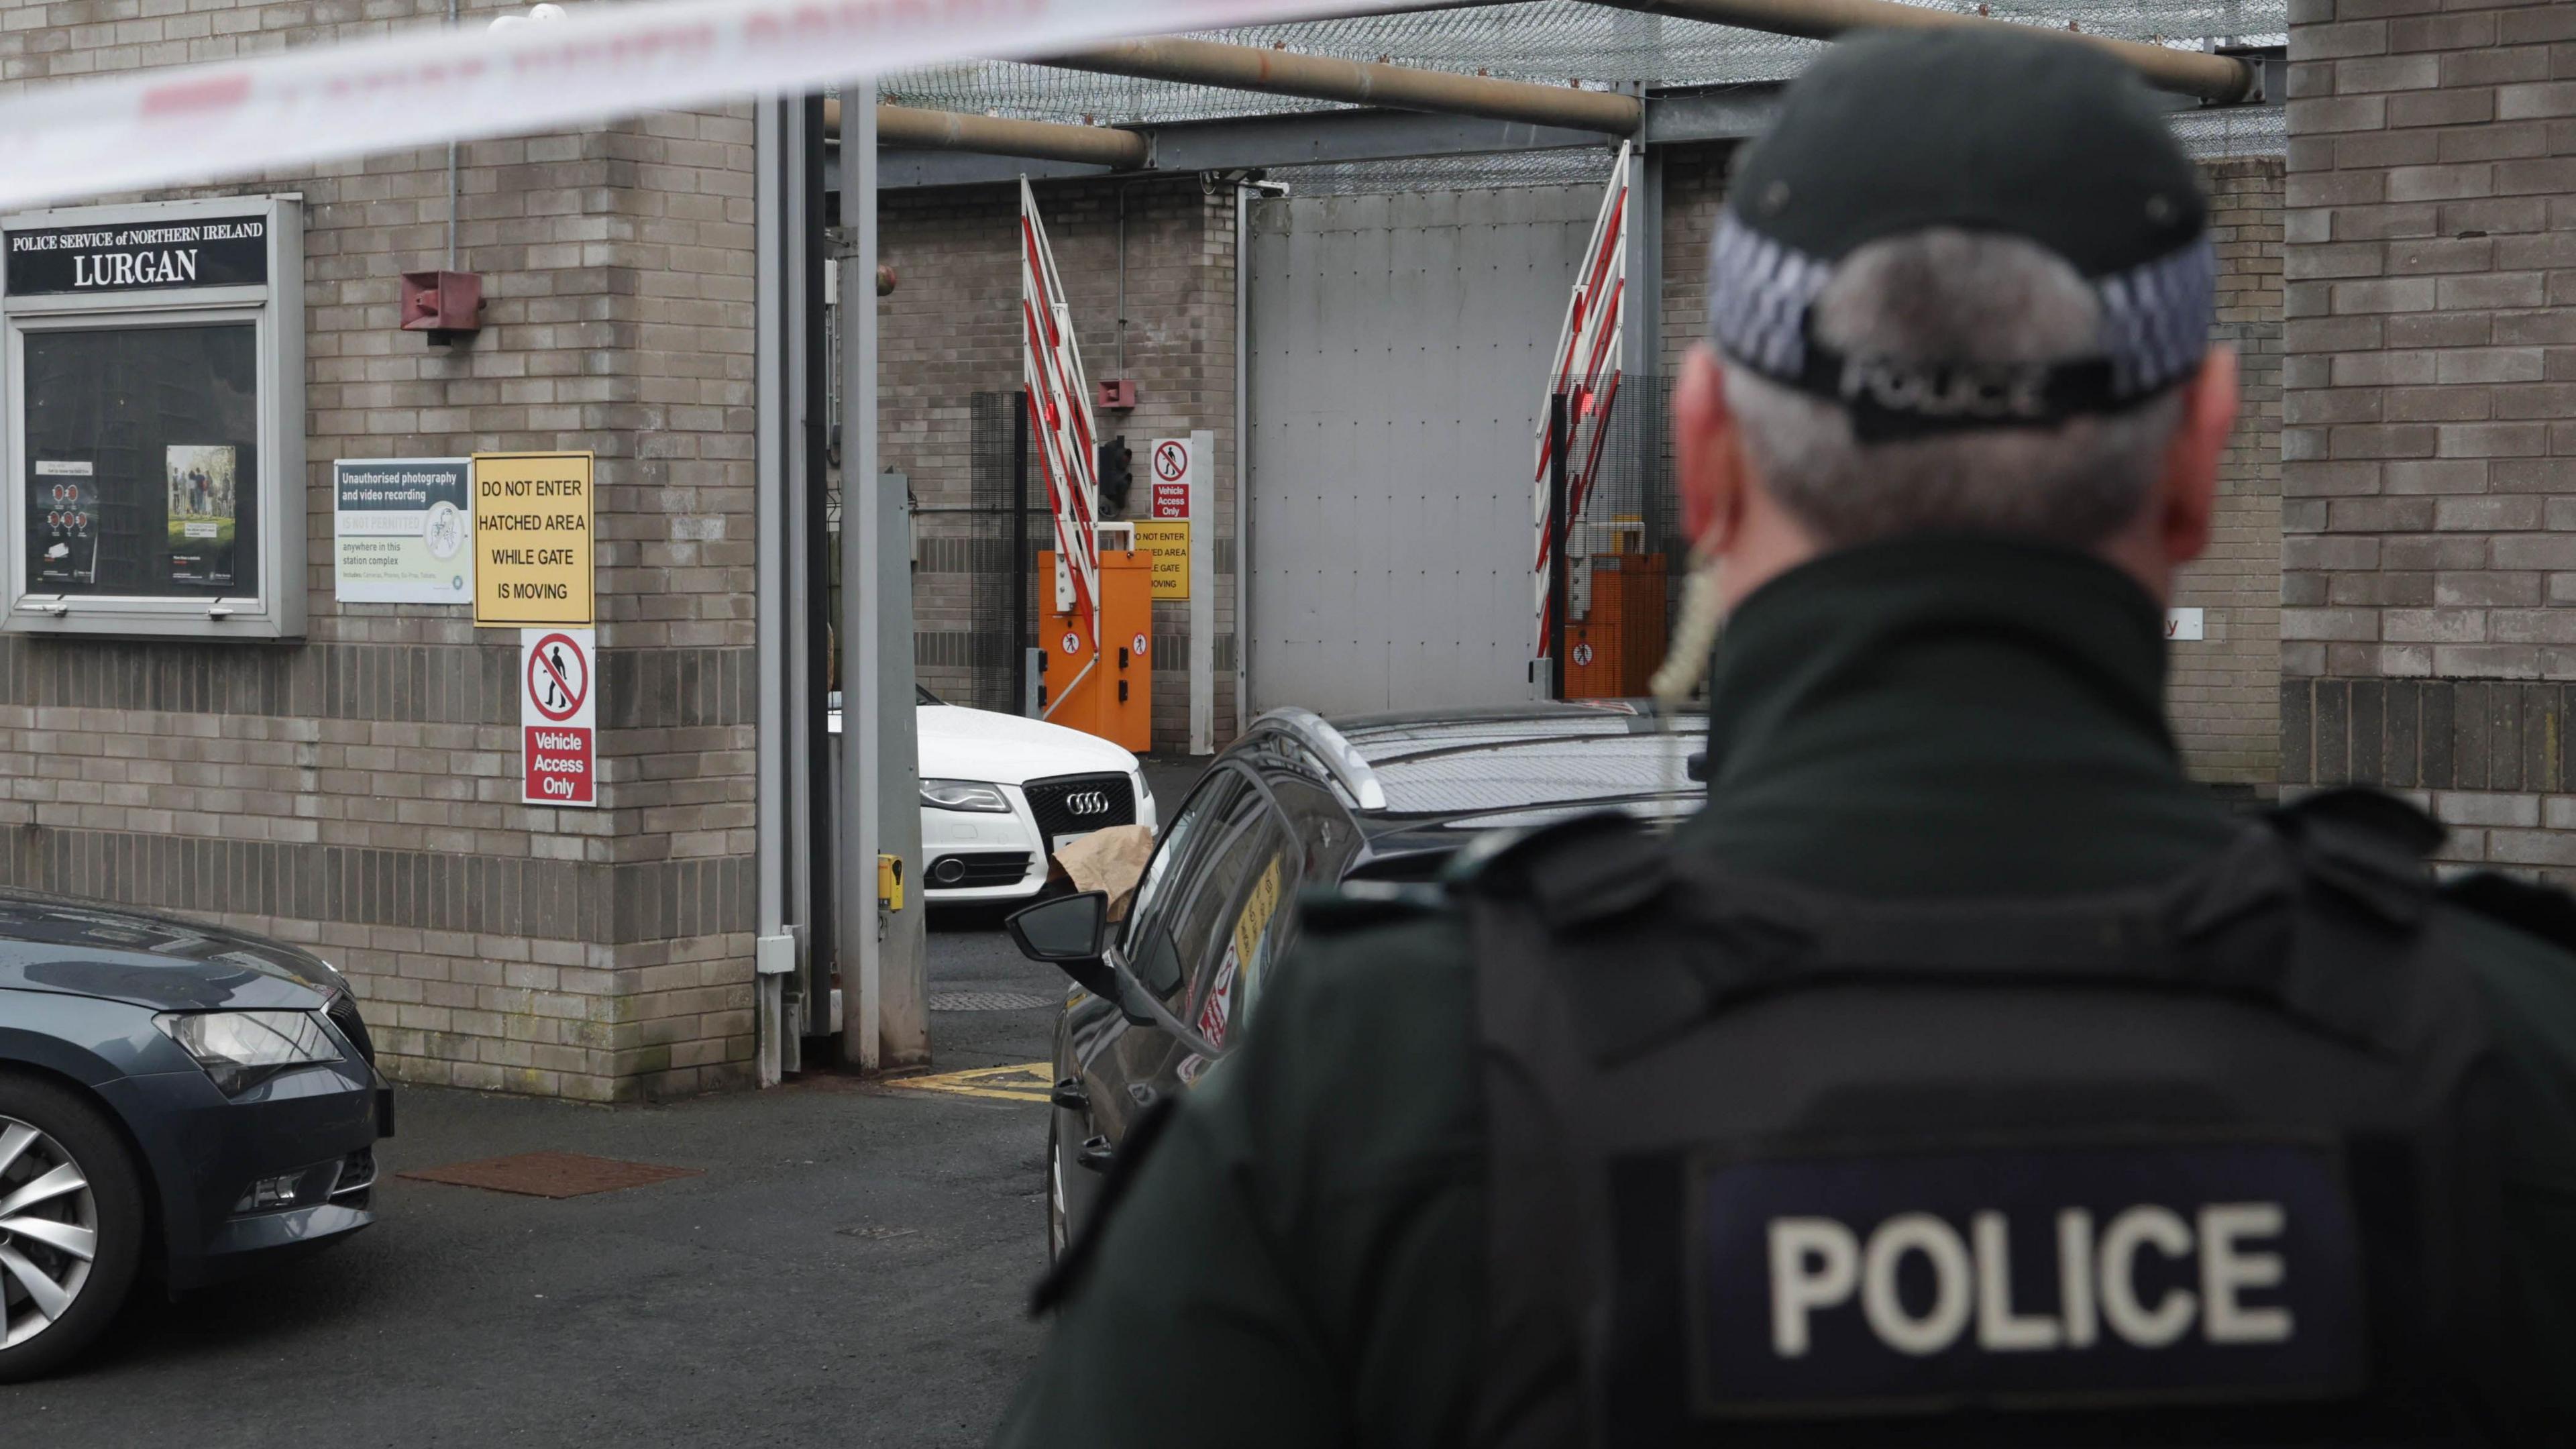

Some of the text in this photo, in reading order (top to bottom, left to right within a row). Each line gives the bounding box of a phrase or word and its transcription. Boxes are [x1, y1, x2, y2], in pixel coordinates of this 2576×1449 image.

[13, 222, 263, 251] POLICE SERVICE of NORTHERN IRELAND
[74, 249, 198, 286] LURGAN
[342, 472, 457, 486] Unauthorised photography
[342, 488, 426, 502] and video recording
[482, 480, 582, 497] DO NOT ENTER
[1159, 486, 1184, 495] Vehicle
[1157, 496, 1185, 505] Access
[1163, 507, 1180, 517] Only
[479, 515, 586, 531] HATCHED AREA
[1160, 533, 1185, 541] ENTER
[343, 542, 400, 553] anywhere in this
[343, 555, 398, 567] station complex
[492, 549, 574, 566] WHILE GATE
[1161, 564, 1180, 572] GATE
[498, 583, 568, 599] IS MOVING
[535, 732, 582, 751] Vehicle
[534, 754, 584, 773] Access
[543, 776, 575, 799] Only
[1766, 1202, 2294, 1359] POLICE
